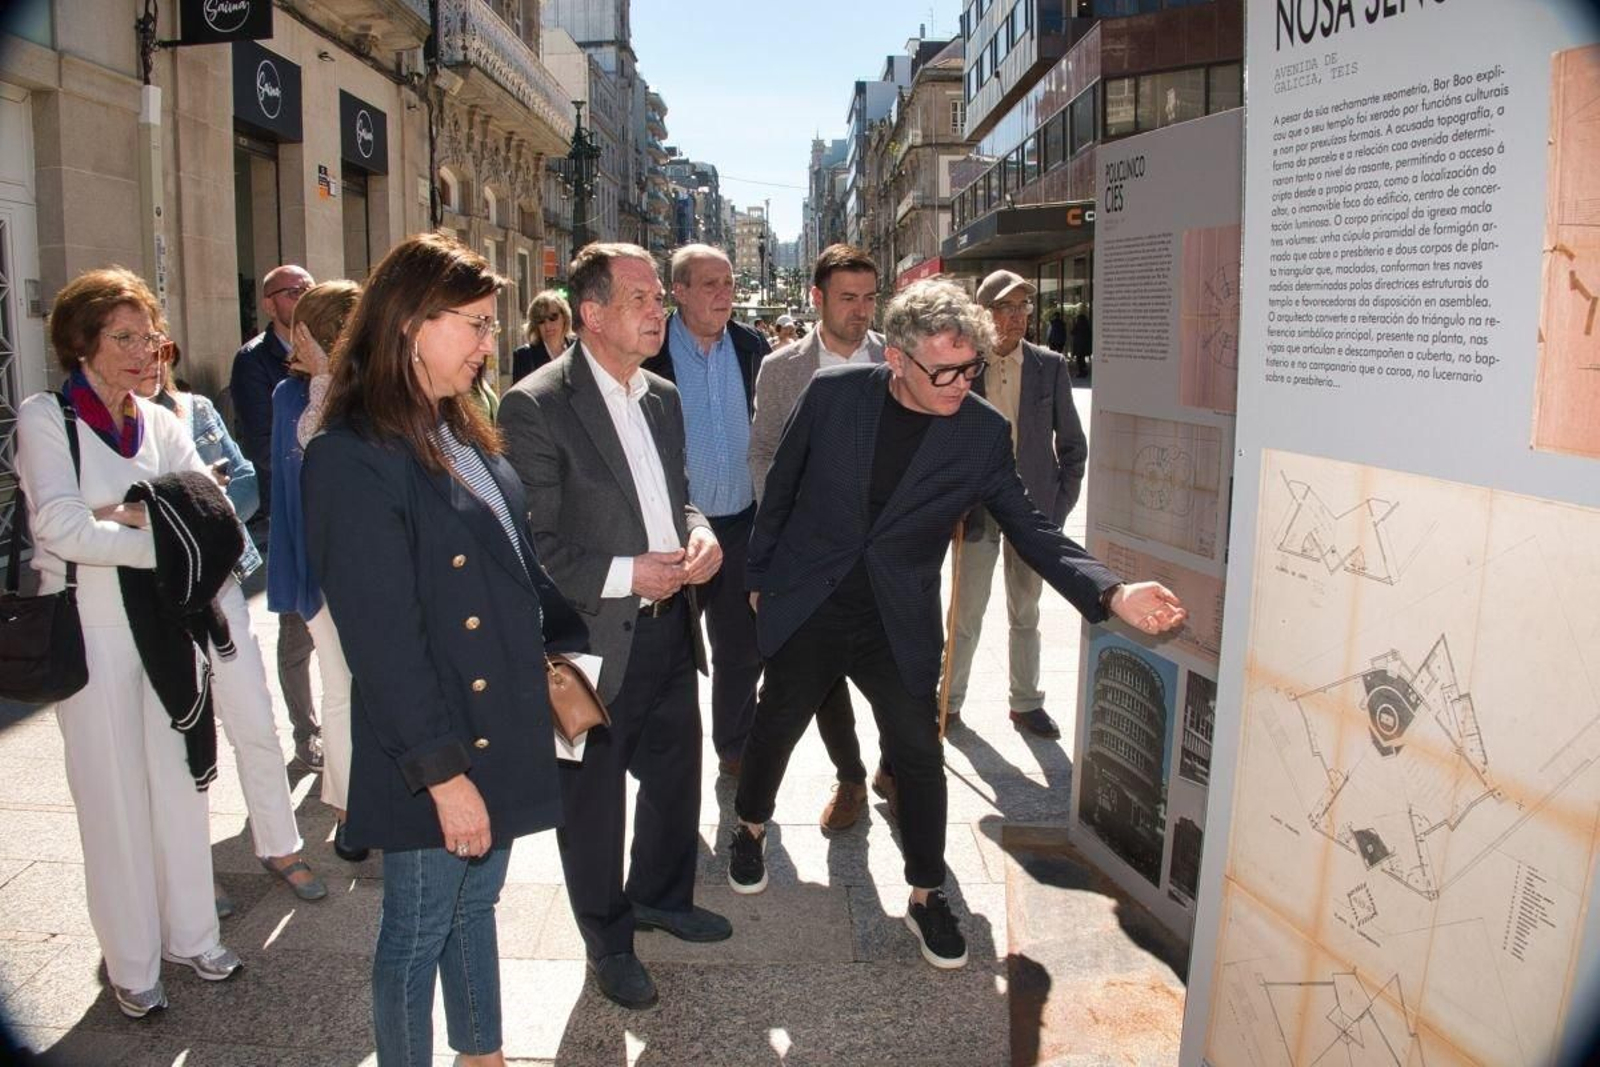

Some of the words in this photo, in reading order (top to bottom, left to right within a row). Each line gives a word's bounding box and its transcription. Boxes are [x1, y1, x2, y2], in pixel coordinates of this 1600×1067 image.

[1276, 0, 1355, 51] NOSA
[1273, 57, 1319, 80] AVENIDA
[1324, 52, 1338, 67] DE
[1273, 74, 1323, 94] GALICIA,
[1331, 61, 1359, 80] TEIS
[1433, 78, 1450, 91] Bar
[1476, 65, 1504, 82] expli-
[1357, 111, 1367, 123] foi
[1370, 105, 1400, 121] xerado
[1403, 104, 1418, 117] por
[1421, 94, 1462, 111] funcións
[1465, 83, 1509, 103] culturais
[1385, 124, 1393, 135] A
[1395, 116, 1434, 134] acusada
[1497, 106, 1504, 116] a
[1355, 142, 1389, 157] relación
[1391, 141, 1408, 152] coa
[1410, 131, 1448, 149] avenida
[1451, 124, 1494, 142] determi-
[1358, 161, 1392, 174] rasante,
[1395, 150, 1446, 171] permitindo
[1449, 152, 1456, 160] o
[1458, 146, 1494, 159] acceso
[1384, 176, 1410, 187] como
[1412, 175, 1418, 183] a
[1421, 165, 1479, 182] localización
[1482, 162, 1496, 175] do
[1363, 193, 1375, 206] do
[1414, 189, 1444, 201] centro
[1446, 185, 1460, 197] de
[1462, 184, 1501, 196] concer-
[1370, 207, 1409, 225] principal
[1411, 206, 1424, 219] da
[1427, 206, 1457, 220] igrexa
[1372, 224, 1416, 242] piramidal
[1418, 224, 1430, 236] de
[1433, 221, 1479, 236] formigón
[1482, 222, 1497, 232] ar-
[1387, 247, 1393, 255] e
[1395, 243, 1417, 255] dous
[1420, 244, 1453, 255] corpos
[1455, 239, 1468, 252] de
[1471, 238, 1498, 254] plan-
[1381, 260, 1430, 272] conforman
[1433, 260, 1450, 271] tres
[1453, 261, 1482, 270] naves
[1374, 278, 1419, 290] directrices
[1422, 276, 1472, 289] estruturais
[1475, 275, 1489, 288] do
[1358, 295, 1370, 307] da
[1372, 295, 1421, 309] disposición
[1424, 298, 1436, 307] en
[1439, 294, 1491, 307] asemblea.
[1350, 315, 1356, 323] a
[1358, 312, 1404, 324] reiteración
[1406, 312, 1419, 324] do
[1422, 313, 1465, 328] triángulo
[1469, 317, 1482, 326] na
[1485, 317, 1500, 326] re-
[1376, 332, 1414, 343] presente
[1417, 334, 1429, 342] na
[1431, 330, 1466, 346] planta,
[1469, 336, 1488, 345] nas
[1416, 348, 1455, 364] cuberta,
[1458, 354, 1472, 363] no
[1475, 351, 1499, 367] bap-
[1359, 365, 1375, 376] que
[1377, 366, 1383, 375] o
[1385, 367, 1415, 379] coroa,
[1417, 369, 1430, 378] no
[1433, 366, 1483, 382] lucernario
